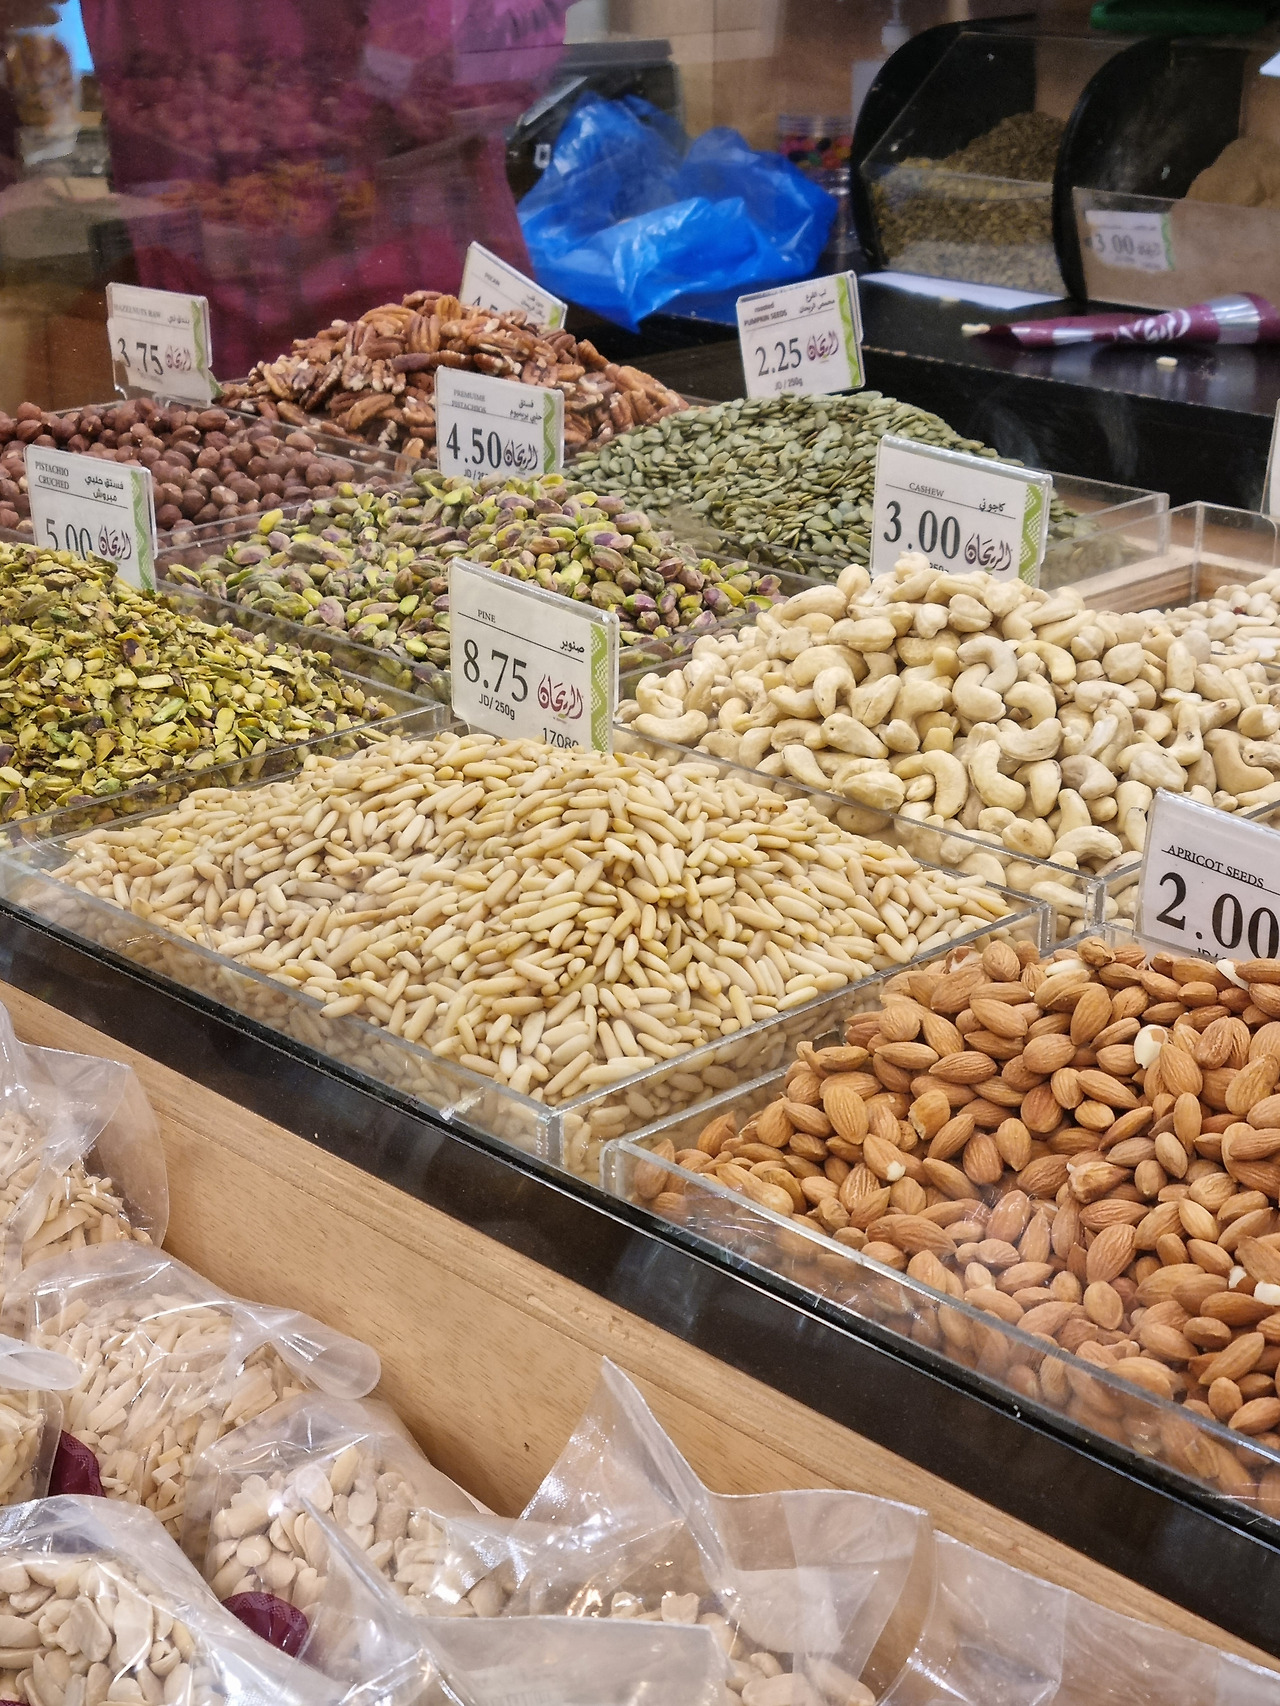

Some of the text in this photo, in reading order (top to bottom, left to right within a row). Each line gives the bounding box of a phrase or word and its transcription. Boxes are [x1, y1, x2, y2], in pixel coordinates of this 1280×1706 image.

[148, 308, 162, 319] RAW
[744, 309, 788, 327] PUMPKIN SEEDS
[117, 337, 163, 376] 3.75
[755, 338, 802, 376] 2.25
[518, 399, 535, 409] فستق
[446, 422, 502, 469] 4.50
[34, 461, 70, 477] PISTACHIO
[38, 474, 70, 490] CRUCHED
[84, 475, 124, 490] فستق حلبي
[908, 481, 945, 498] CASHEW
[92, 487, 118, 503] مبروش
[979, 498, 1006, 513] كاجوني
[883, 500, 961, 560] 3.00
[964, 532, 1013, 571] الريحان
[477, 609, 496, 624] PINE
[560, 640, 585, 654] صنوبر
[463, 639, 528, 703] 8.75
[537, 673, 584, 720] الريحان
[495, 699, 515, 721] 250g
[1168, 844, 1265, 889] APRICOT SEEDS
[1156, 871, 1280, 959] 2.00
